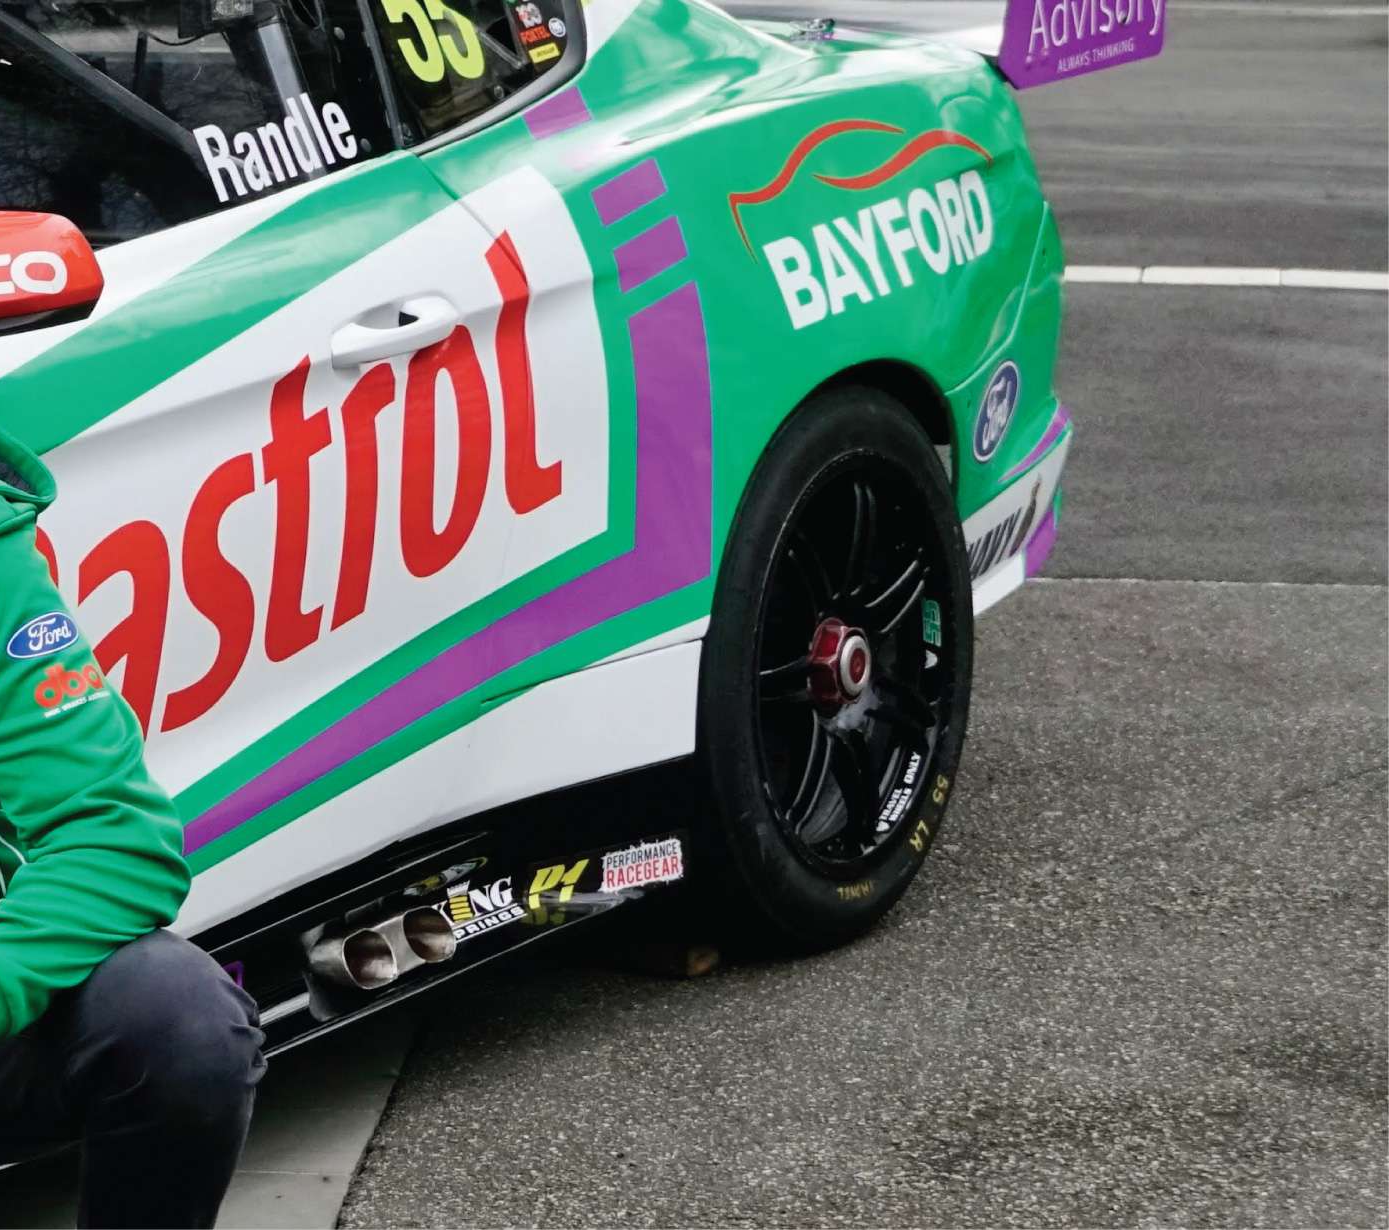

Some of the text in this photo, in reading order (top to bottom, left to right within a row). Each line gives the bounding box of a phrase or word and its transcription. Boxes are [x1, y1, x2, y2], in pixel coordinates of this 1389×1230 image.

[192, 91, 359, 204] Randle
[762, 169, 994, 331] BAYFORD
[36, 229, 563, 742] astrol
[27, 617, 72, 652] Ford
[606, 841, 679, 869] PERFORMANCE
[606, 855, 680, 889] RACEGEAR
[454, 904, 526, 940] PRINGS
